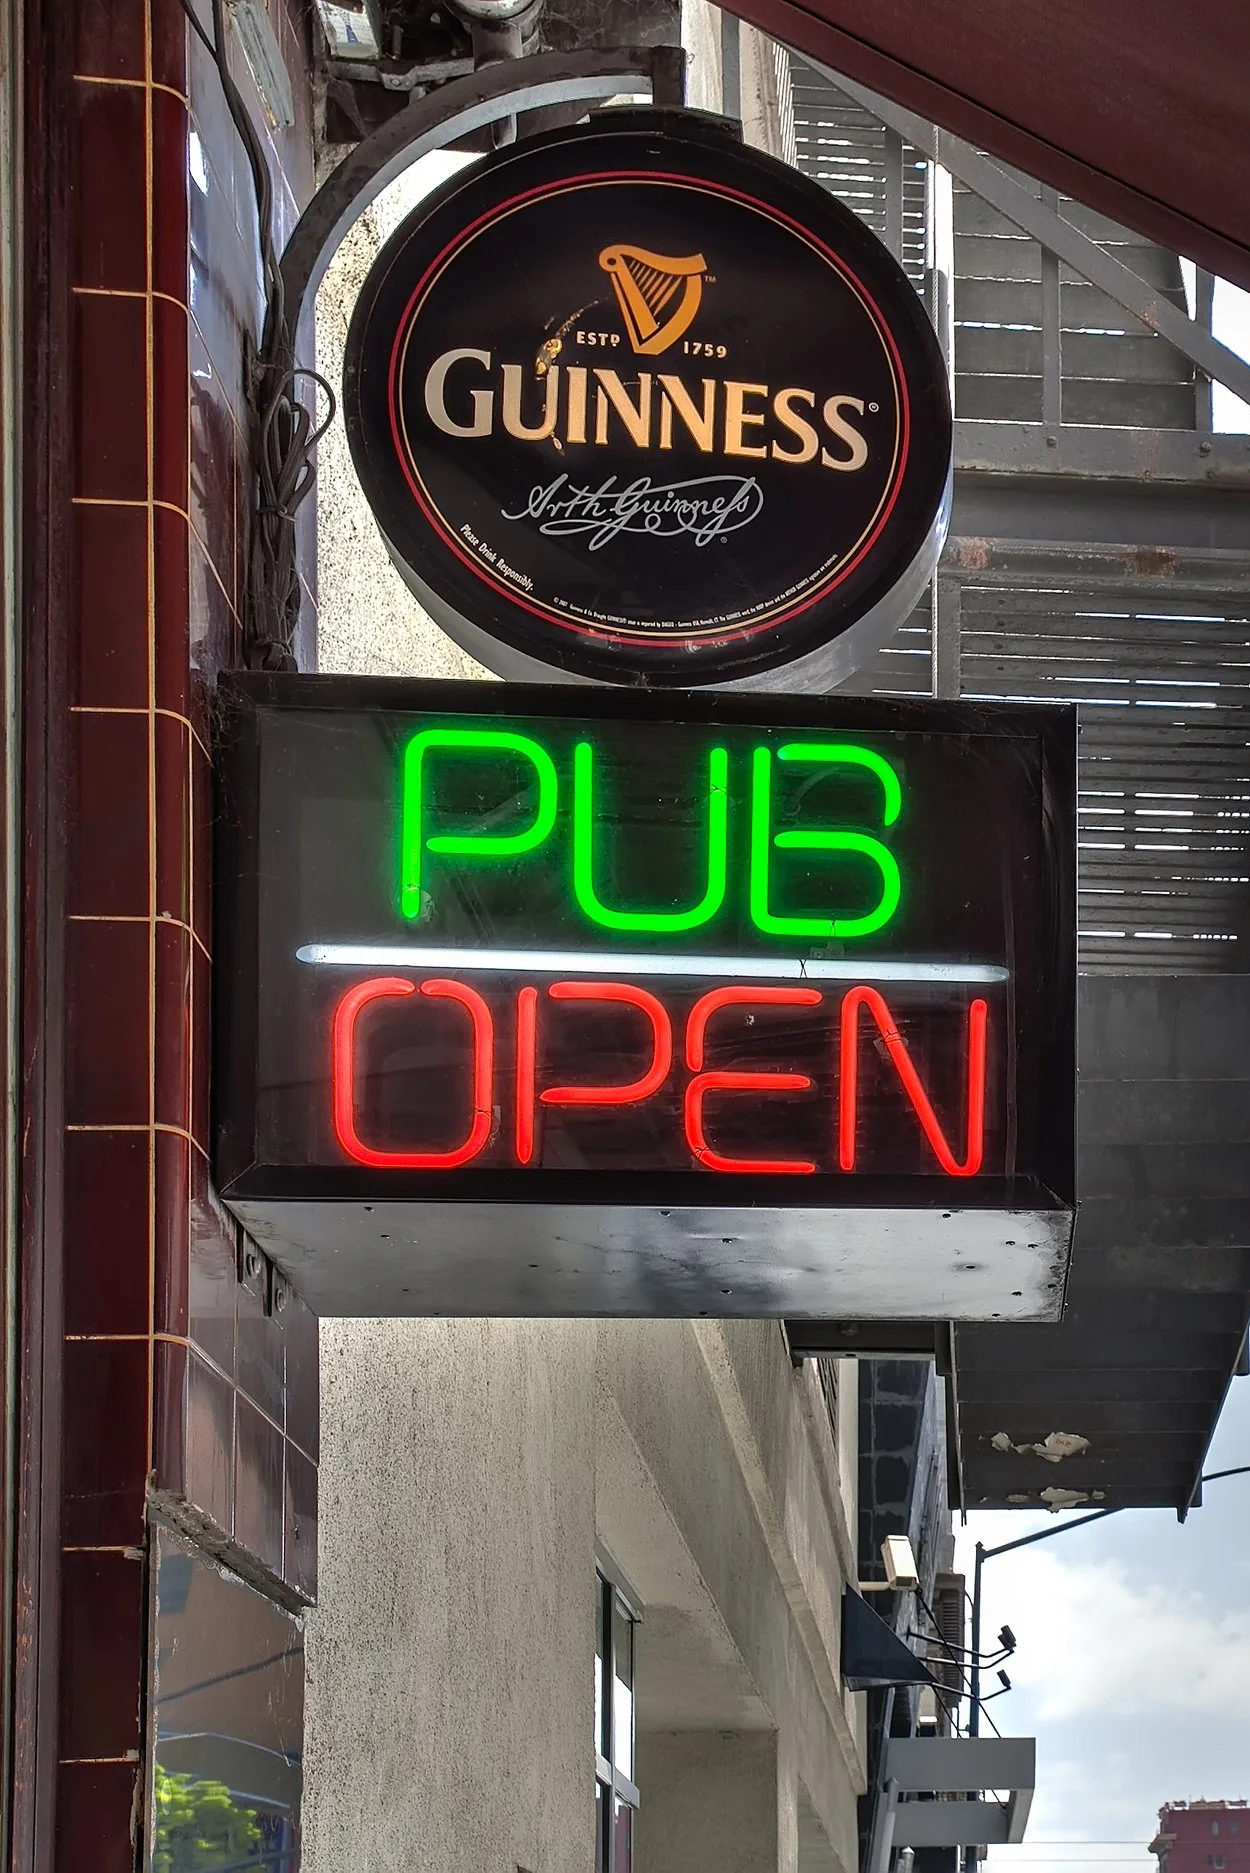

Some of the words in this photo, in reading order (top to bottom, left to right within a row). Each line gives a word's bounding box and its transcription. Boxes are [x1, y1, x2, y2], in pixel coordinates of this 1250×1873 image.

[424, 347, 869, 472] GUINNESS
[683, 341, 728, 359] 1759
[460, 523, 480, 546] Please
[478, 542, 498, 563] Drink
[496, 558, 534, 592] Responsibly.
[400, 727, 903, 937] PUB
[332, 976, 988, 1177] OPEN
